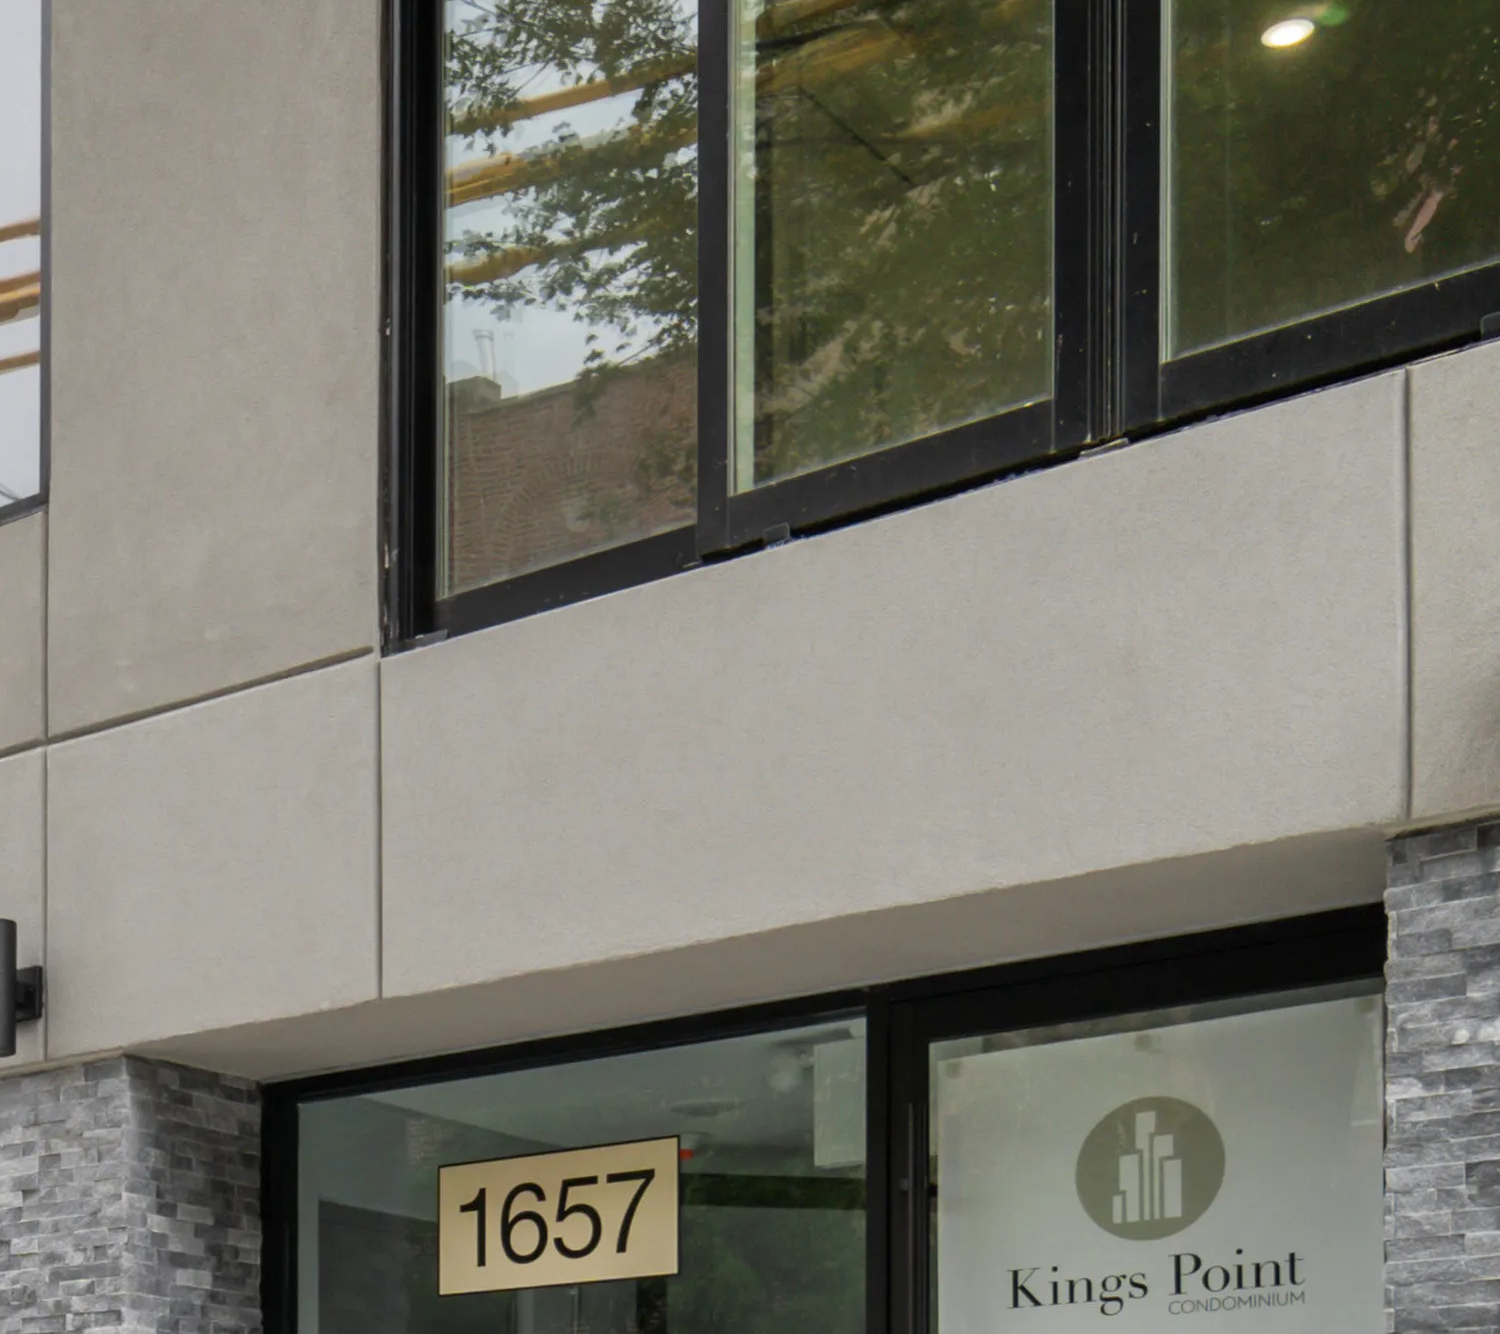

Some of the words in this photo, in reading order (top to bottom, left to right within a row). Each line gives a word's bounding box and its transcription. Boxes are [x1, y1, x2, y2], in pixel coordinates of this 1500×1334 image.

[460, 1168, 655, 1267] 1657
[1006, 1265, 1148, 1317] Kings
[1168, 1248, 1306, 1296] Point
[1168, 1290, 1306, 1315] CONDOMINIUM
